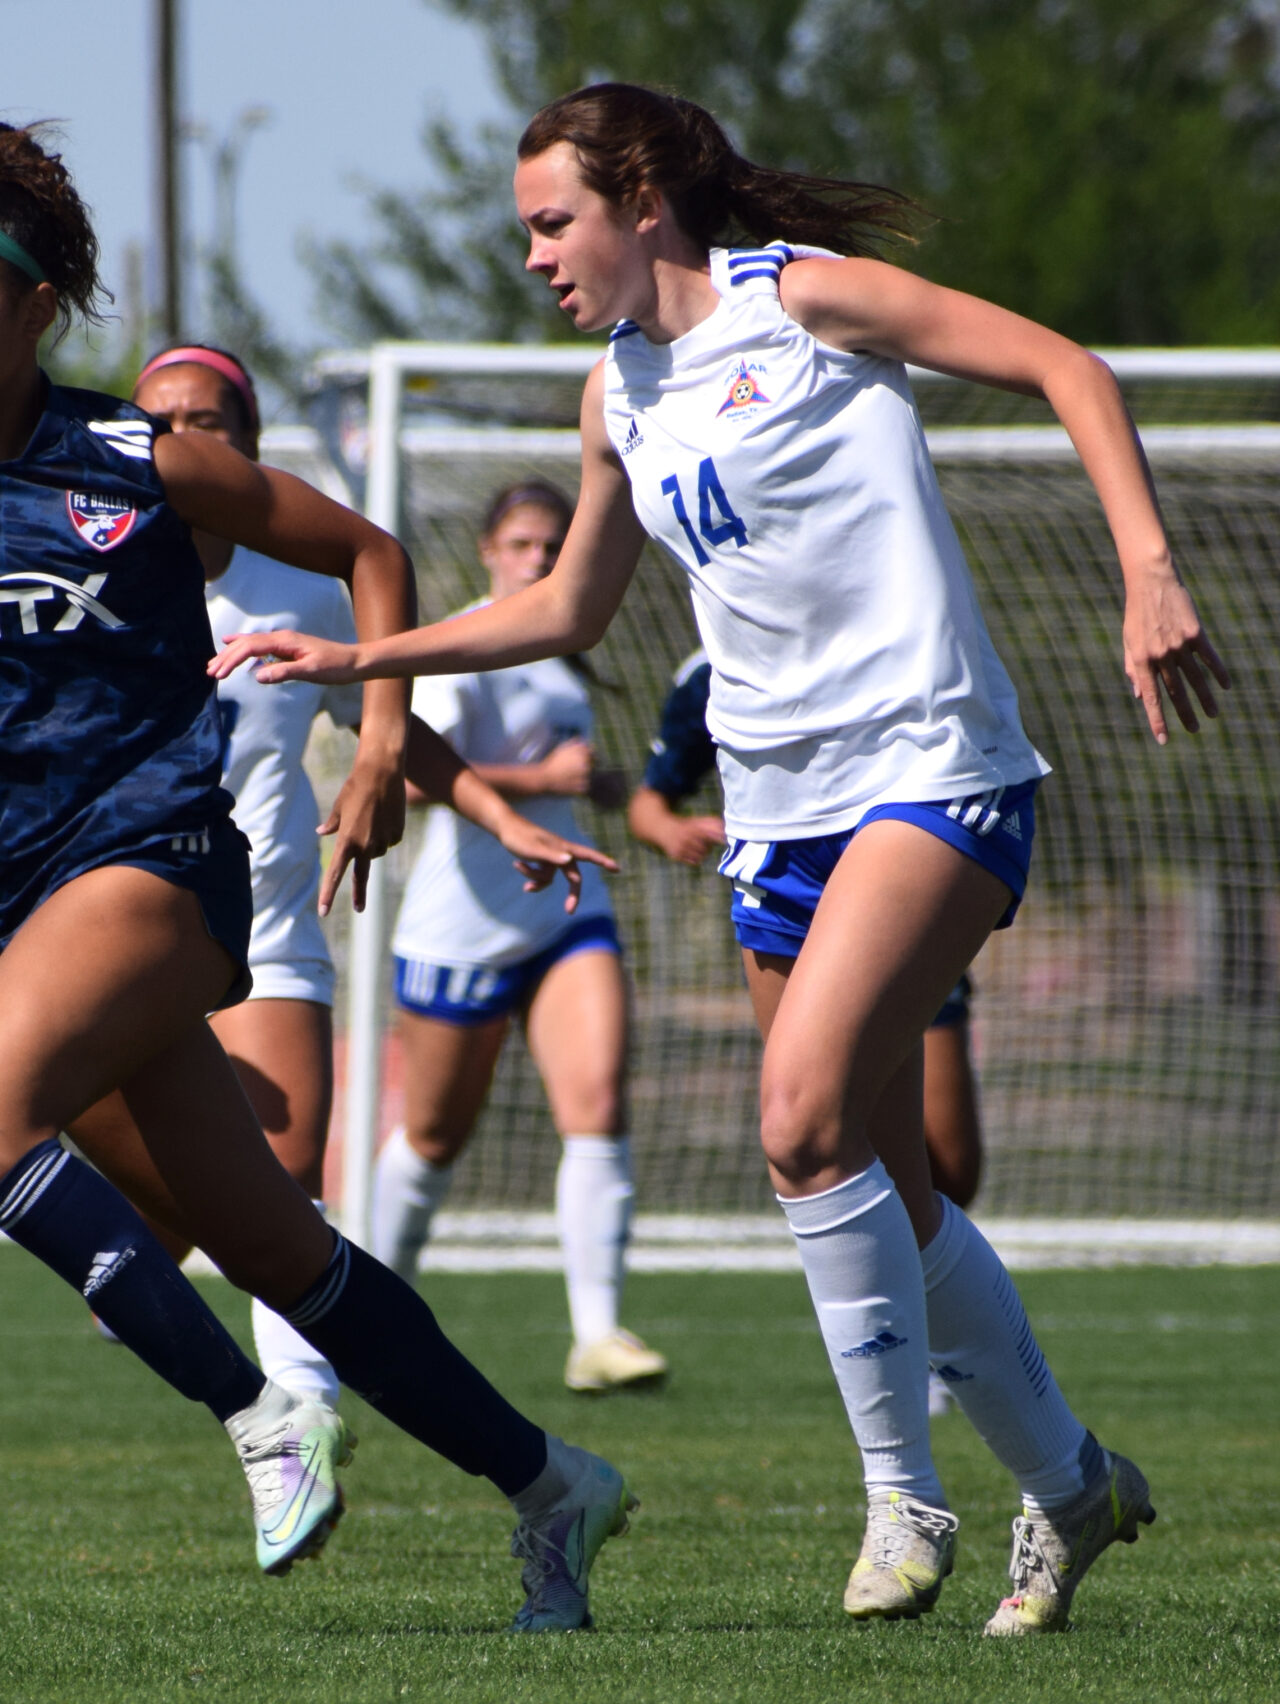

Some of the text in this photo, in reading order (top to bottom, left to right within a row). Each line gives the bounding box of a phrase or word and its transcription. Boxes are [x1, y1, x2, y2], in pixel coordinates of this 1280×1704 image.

[74, 494, 129, 510] FC DALLAS
[661, 456, 749, 568] 14
